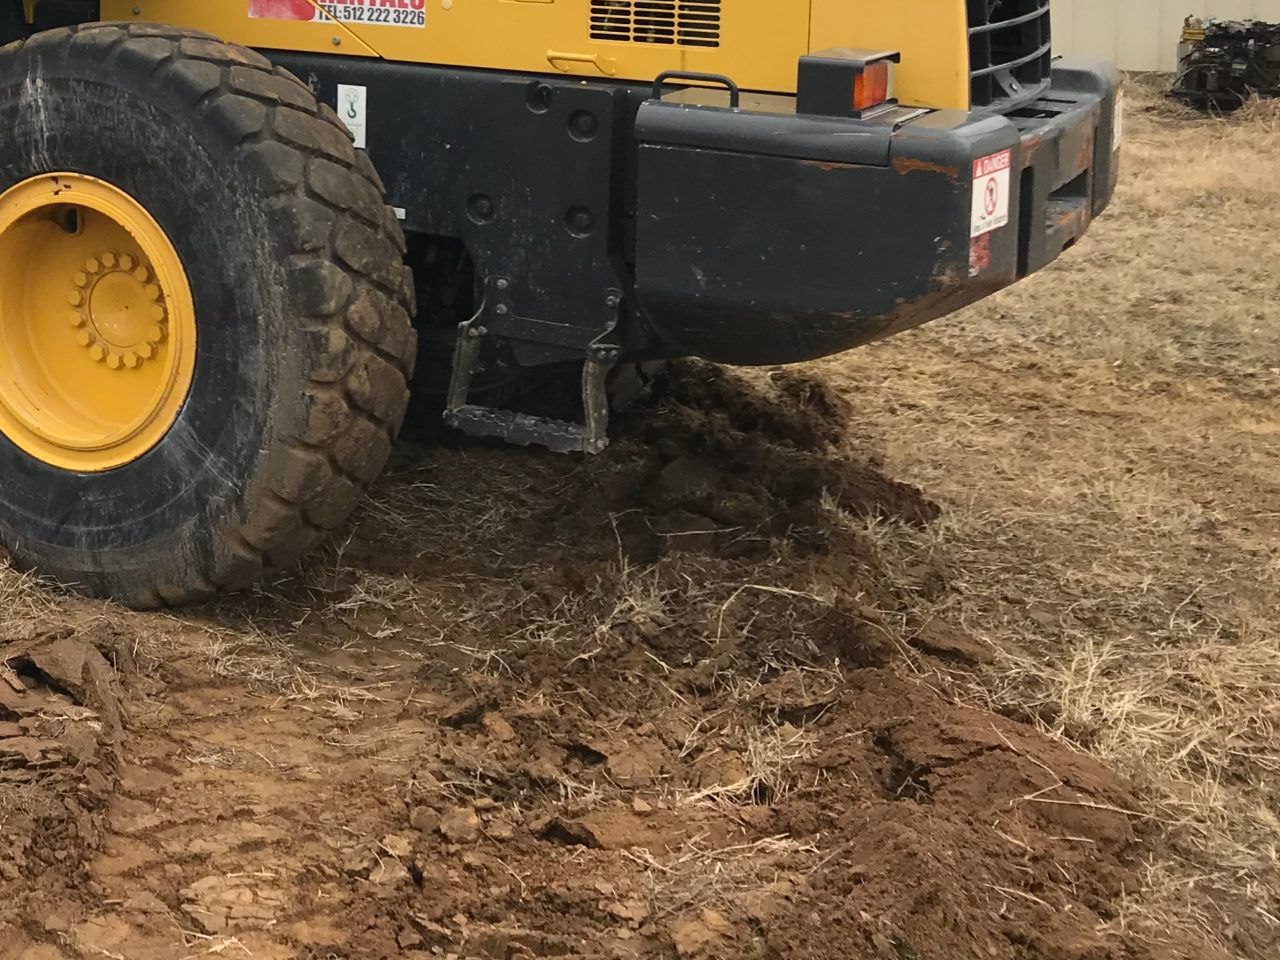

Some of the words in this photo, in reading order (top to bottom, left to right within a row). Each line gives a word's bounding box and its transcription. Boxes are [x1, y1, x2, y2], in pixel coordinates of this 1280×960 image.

[367, 8, 390, 23] 222
[393, 10, 425, 25] 3226
[983, 153, 1008, 173] DANGER
